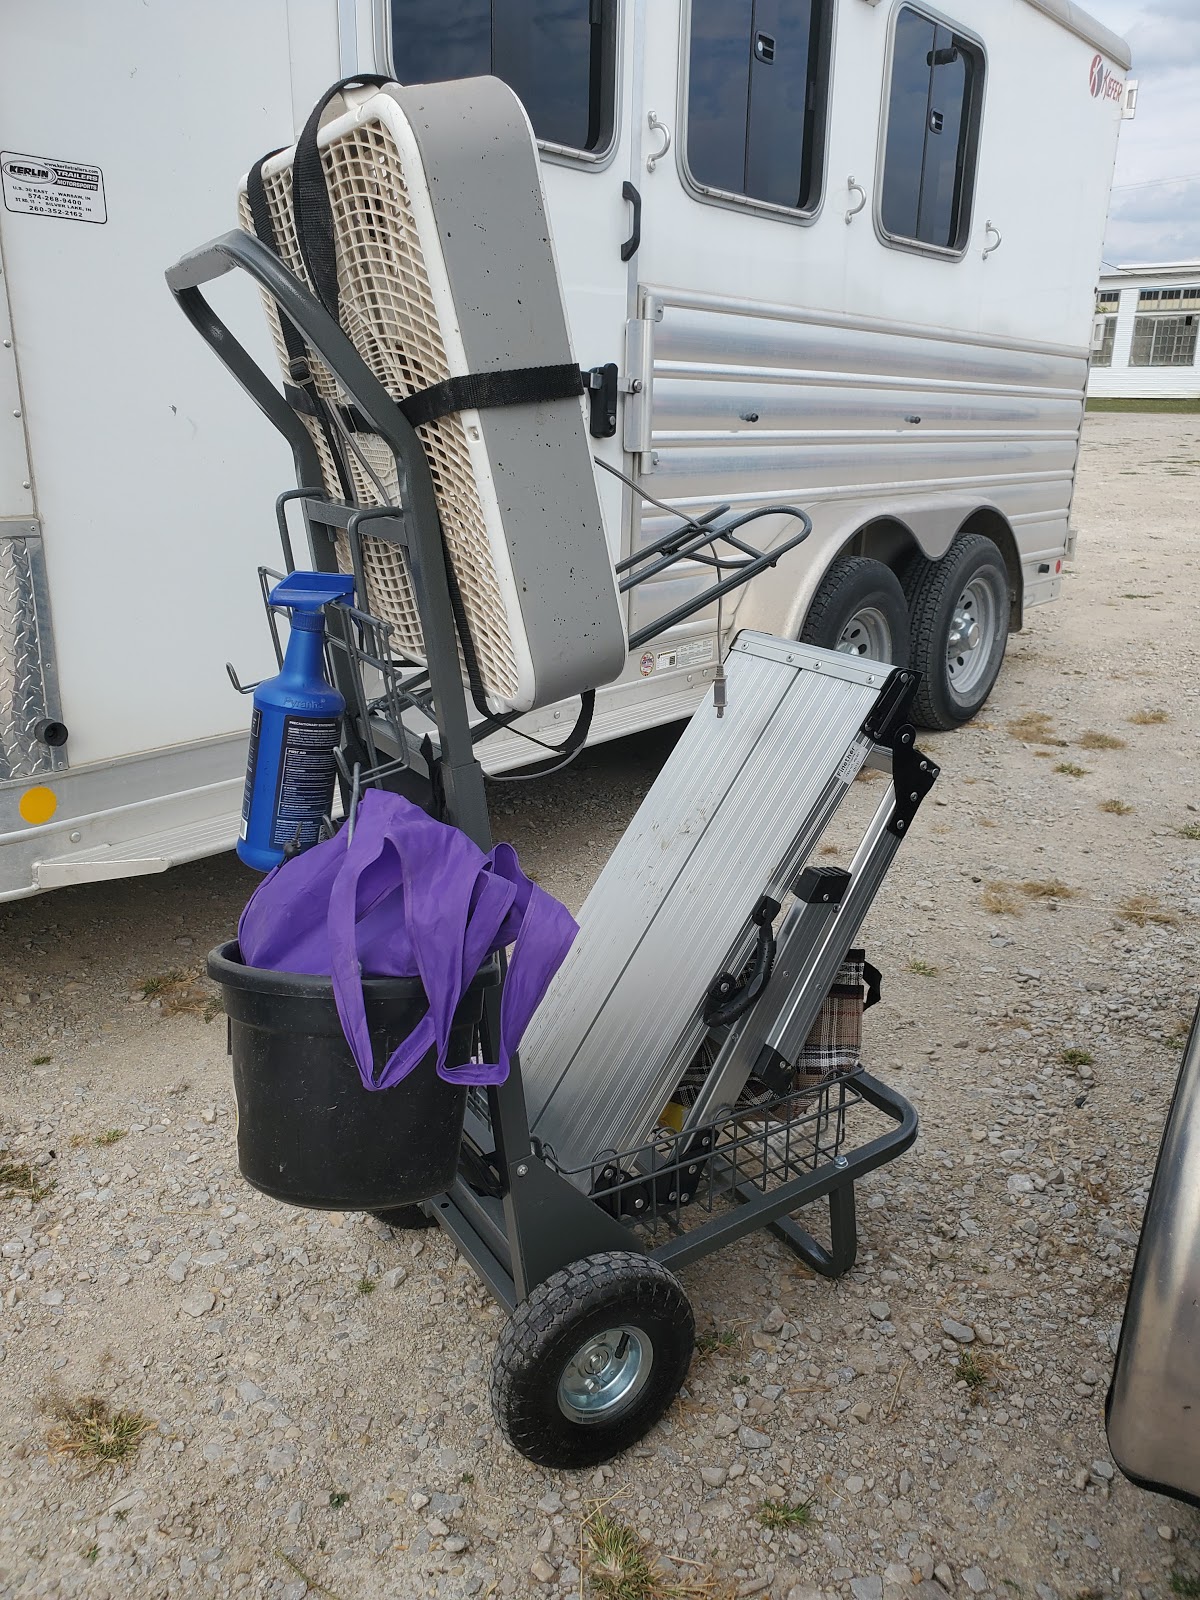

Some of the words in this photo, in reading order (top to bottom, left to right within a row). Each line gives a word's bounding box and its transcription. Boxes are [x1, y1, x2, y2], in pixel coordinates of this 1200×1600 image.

[1101, 68, 1122, 102] KIEFER
[9, 164, 49, 178] KERLIN
[57, 170, 98, 182] TRAILERS
[57, 179, 98, 190] MOTORSPORTS
[28, 193, 82, 206] 574-268-9400
[45, 201, 66, 209] SILVER
[29, 206, 83, 217] 260-352-2162
[837, 747, 855, 777] Finether
